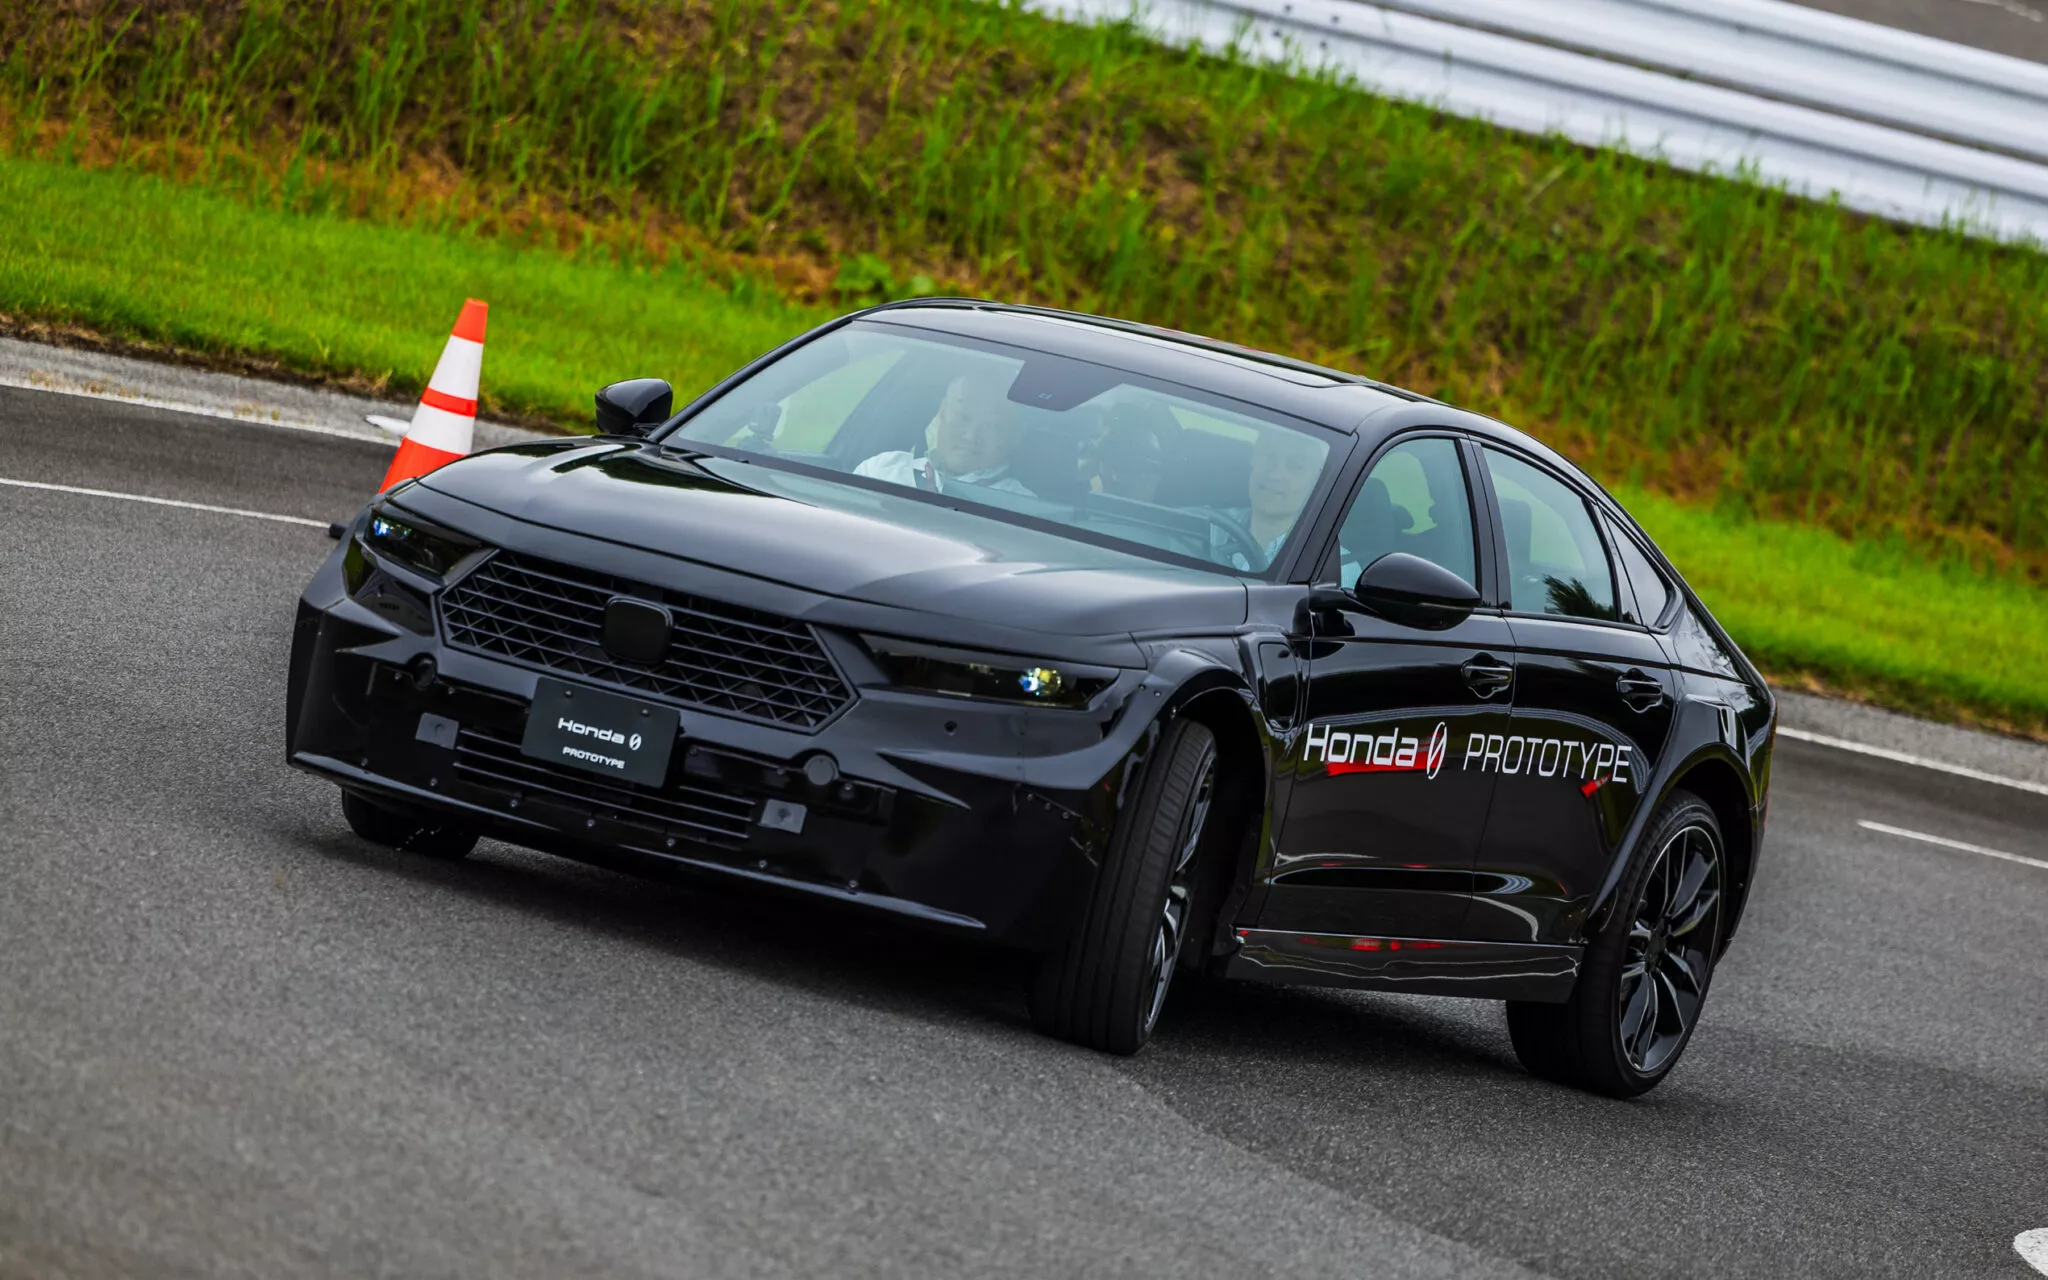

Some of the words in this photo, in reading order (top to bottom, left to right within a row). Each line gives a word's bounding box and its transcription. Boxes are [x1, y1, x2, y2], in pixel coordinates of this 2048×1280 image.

[557, 717, 626, 745] Honda
[562, 746, 626, 770] PROTOTYPE
[1303, 723, 1419, 767] Honda
[1462, 733, 1633, 783] PROTOTYPE
